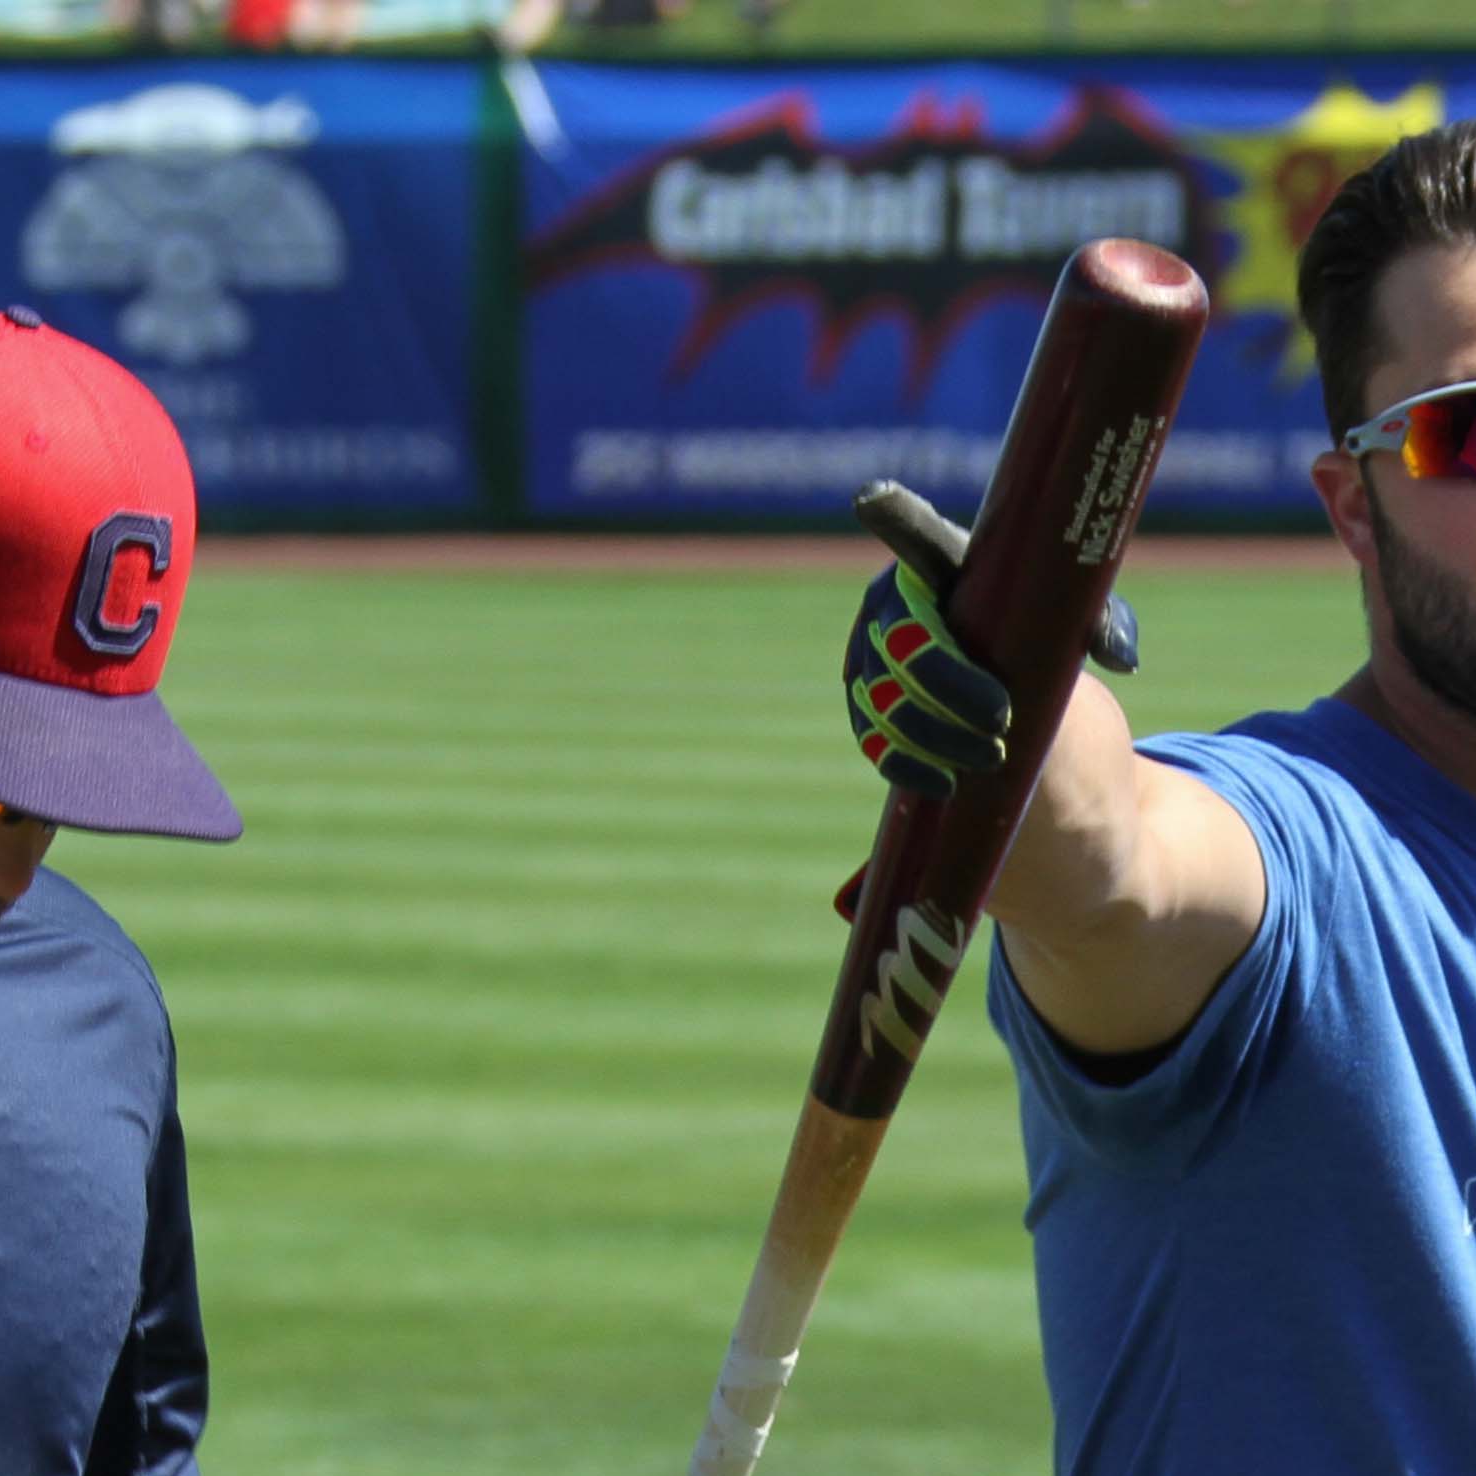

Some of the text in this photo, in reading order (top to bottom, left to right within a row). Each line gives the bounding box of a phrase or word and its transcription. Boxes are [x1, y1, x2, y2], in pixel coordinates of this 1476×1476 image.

[1076, 513, 1117, 565] Nick
[1098, 413, 1152, 509] Swisher
[74, 507, 173, 656] C
